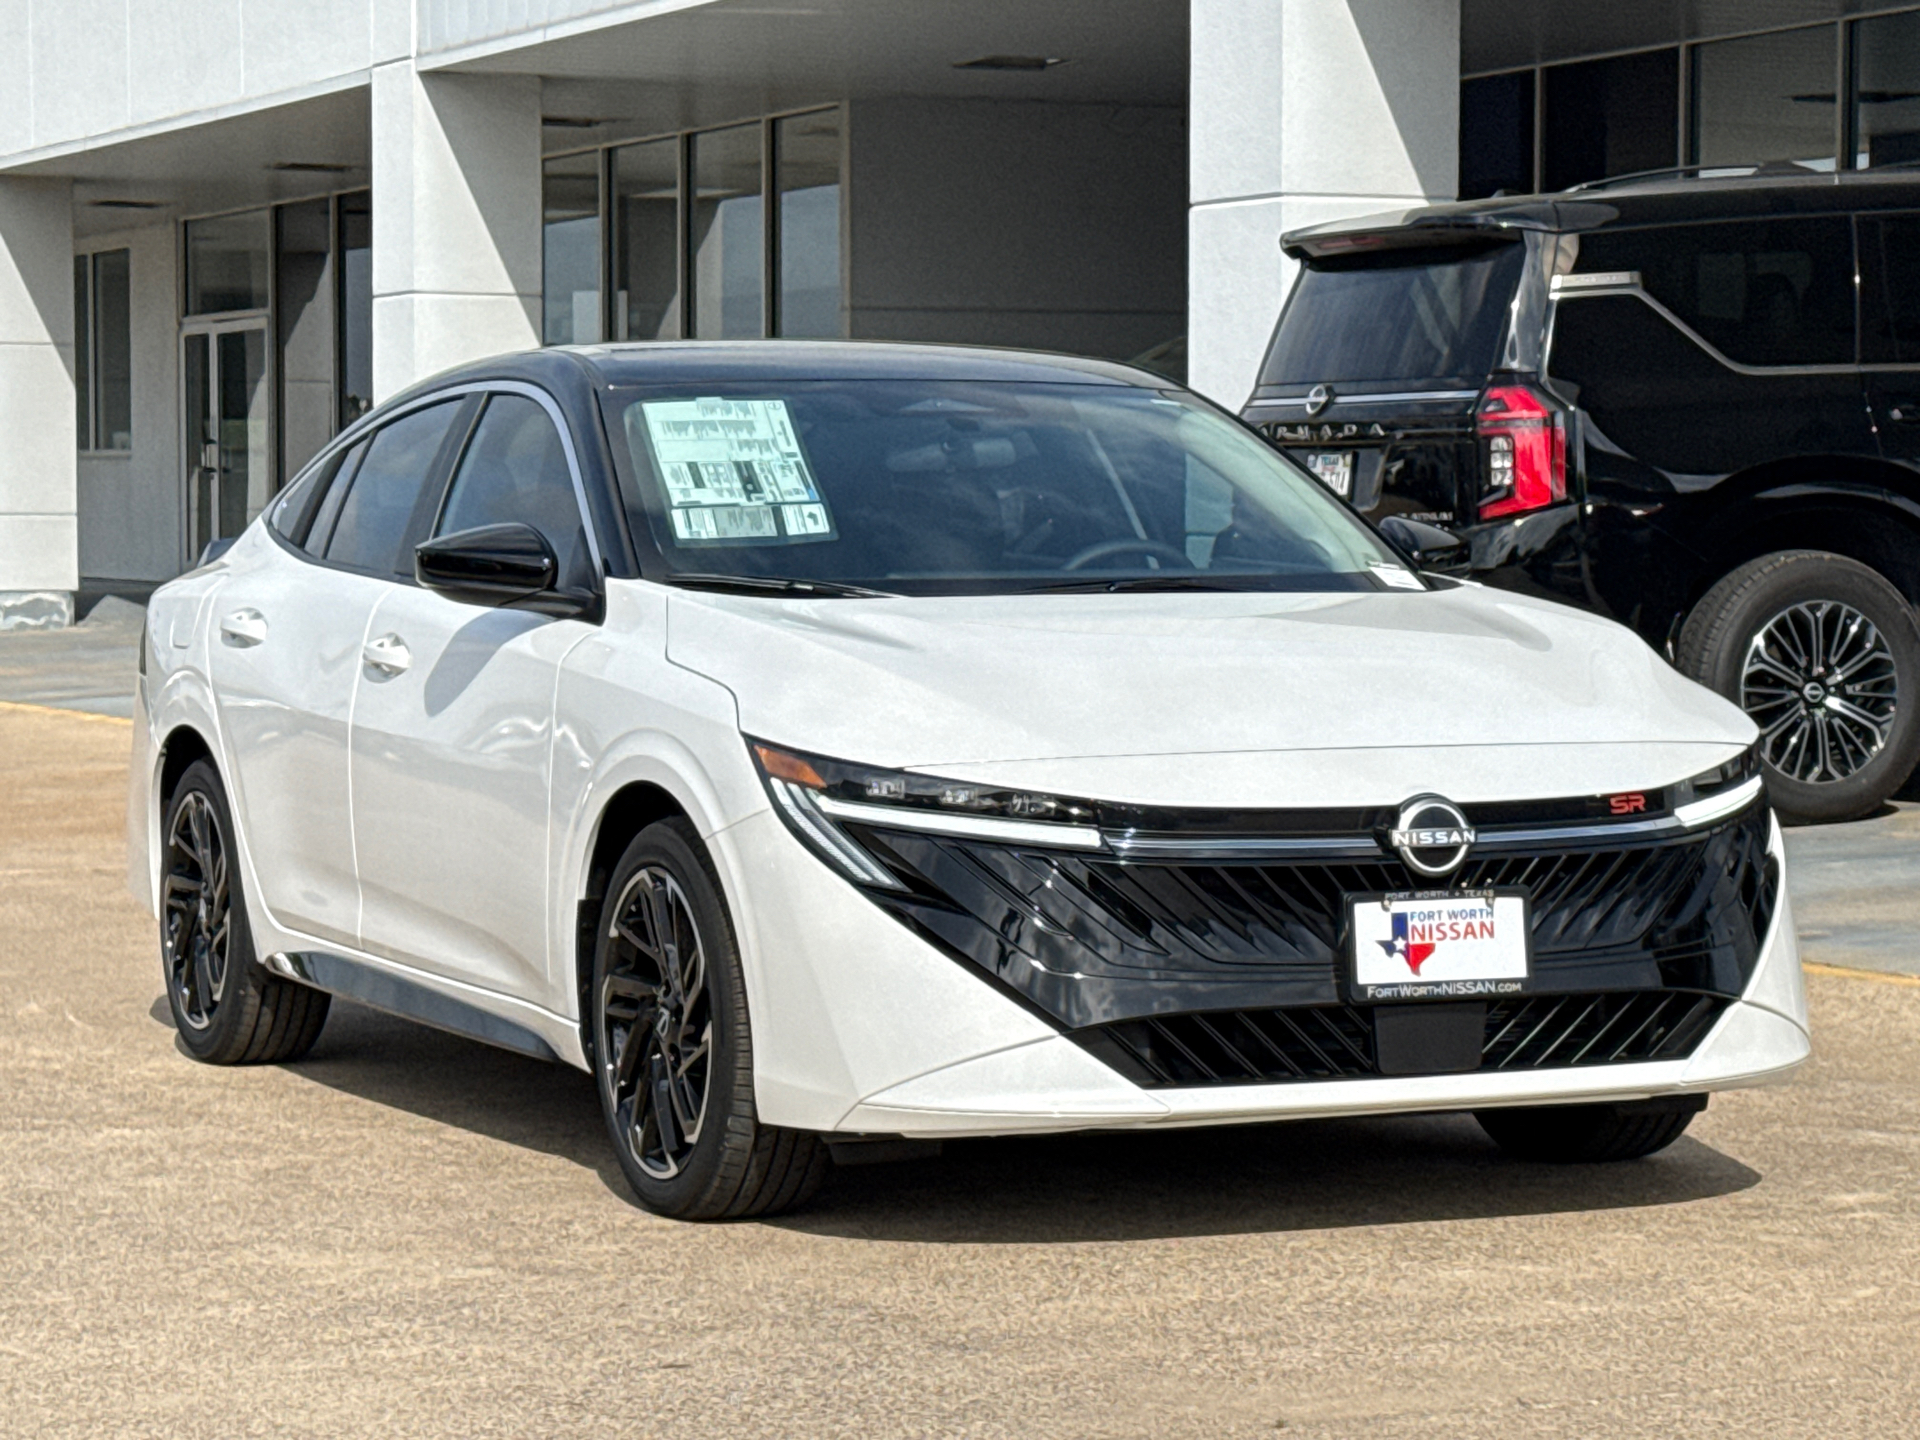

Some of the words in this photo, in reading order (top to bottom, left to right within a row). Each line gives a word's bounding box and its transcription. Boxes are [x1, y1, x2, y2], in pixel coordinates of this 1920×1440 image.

[1610, 794, 1646, 814] SR
[1392, 829, 1475, 847] NISSAN
[1384, 892, 1411, 900] FORT
[1414, 890, 1449, 899] WORTH
[1463, 889, 1494, 898] TEXAS
[1410, 910, 1443, 922] FORT
[1447, 908, 1494, 921] WORTH
[1411, 920, 1495, 941] NISSAN
